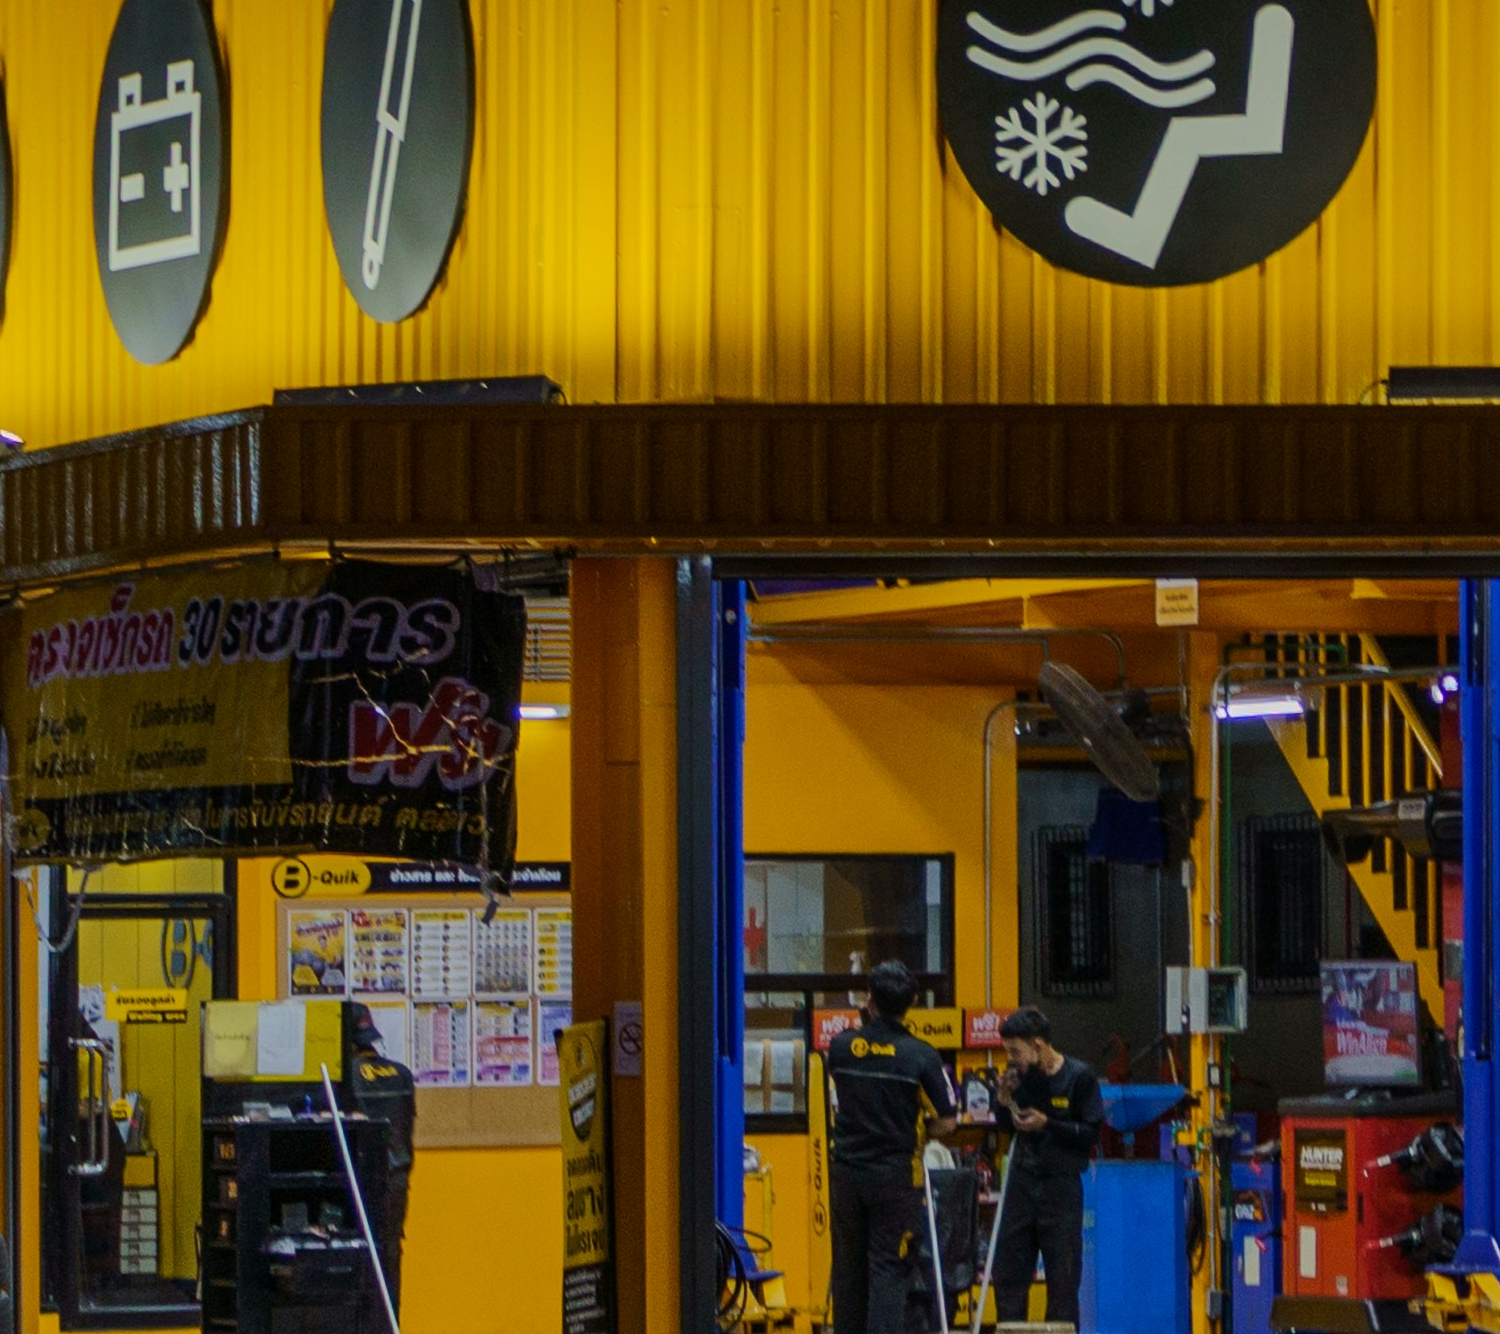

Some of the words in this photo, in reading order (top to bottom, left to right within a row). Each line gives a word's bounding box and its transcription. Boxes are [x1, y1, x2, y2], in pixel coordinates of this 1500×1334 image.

[178, 595, 224, 664] 30
[221, 593, 461, 665] รายการ
[272, 856, 360, 898] B-Quik
